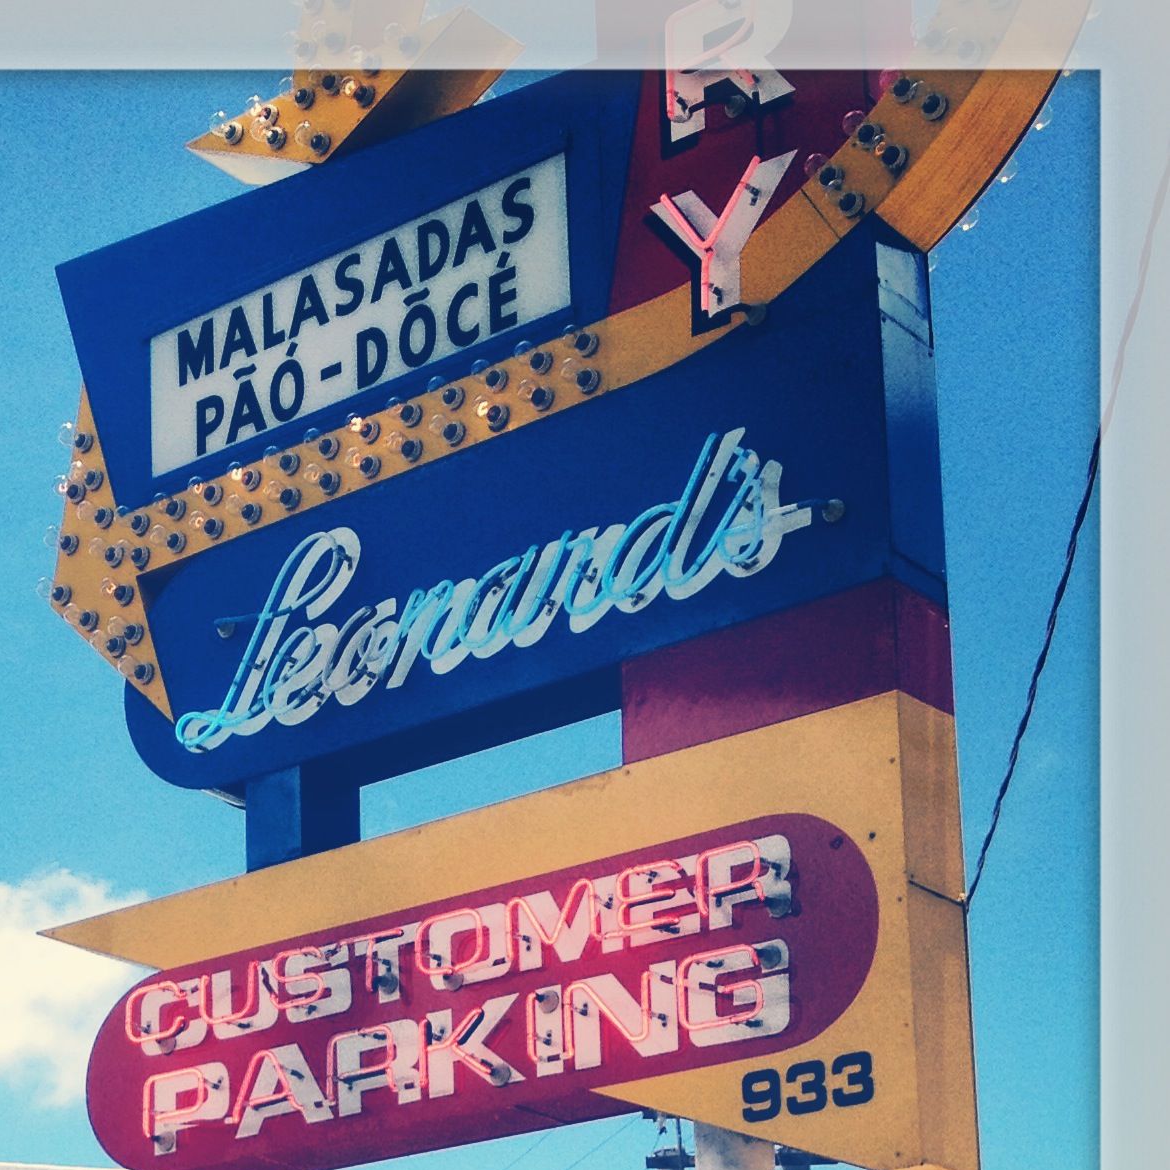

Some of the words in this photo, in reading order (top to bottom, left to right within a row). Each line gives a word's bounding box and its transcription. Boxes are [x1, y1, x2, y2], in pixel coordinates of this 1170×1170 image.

[176, 176, 536, 388] MALASADAS
[176, 427, 812, 753] Leonard's
[125, 833, 792, 1056] CUSTOMER
[141, 938, 790, 1156] PARKING
[741, 1051, 875, 1123] 933
